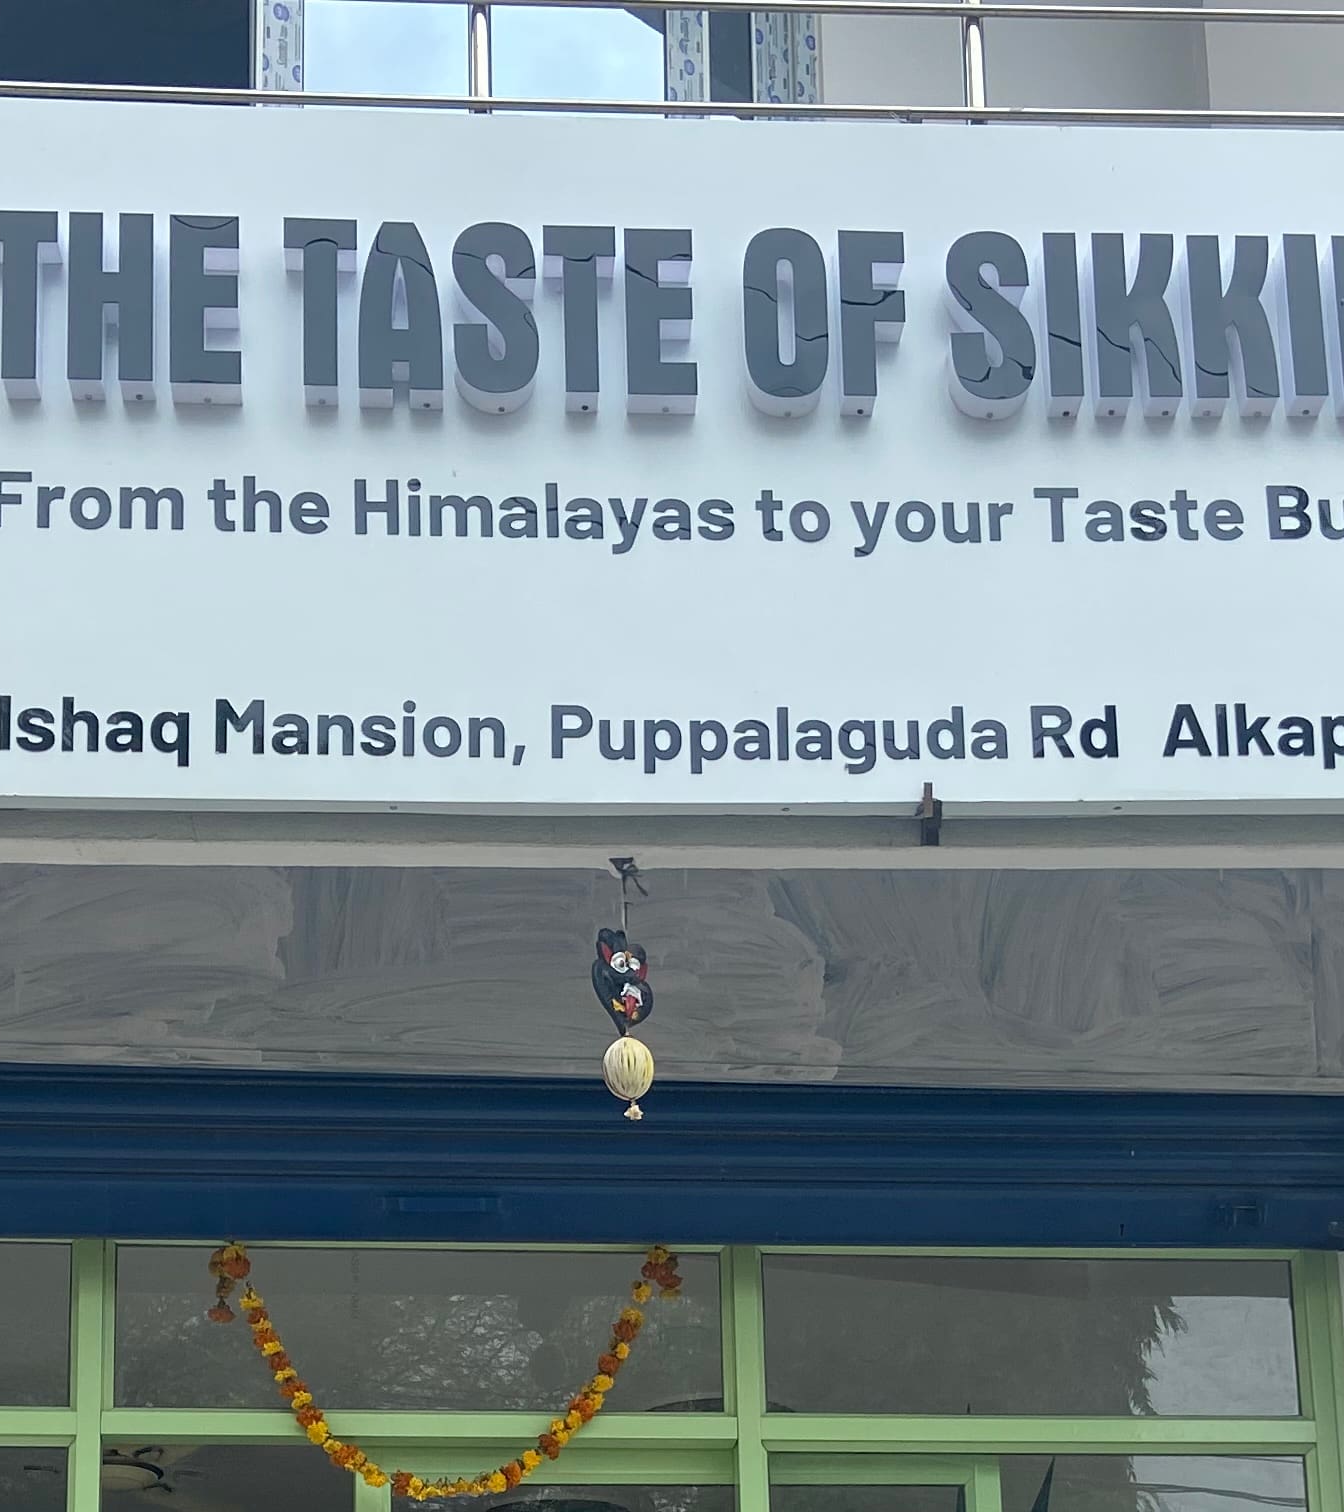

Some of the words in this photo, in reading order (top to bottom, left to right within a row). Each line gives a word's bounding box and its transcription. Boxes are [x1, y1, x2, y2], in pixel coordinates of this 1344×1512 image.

[283, 216, 699, 400] TASTE
[742, 227, 906, 399] OF
[207, 475, 330, 535] the
[354, 478, 735, 555] Himalayas
[755, 489, 831, 543] to
[850, 500, 1014, 558] your
[1033, 487, 1244, 543] Taste
[215, 698, 526, 767] Mansion,
[551, 704, 1009, 775] Puppalaguda
[1030, 704, 1119, 760] Rd
